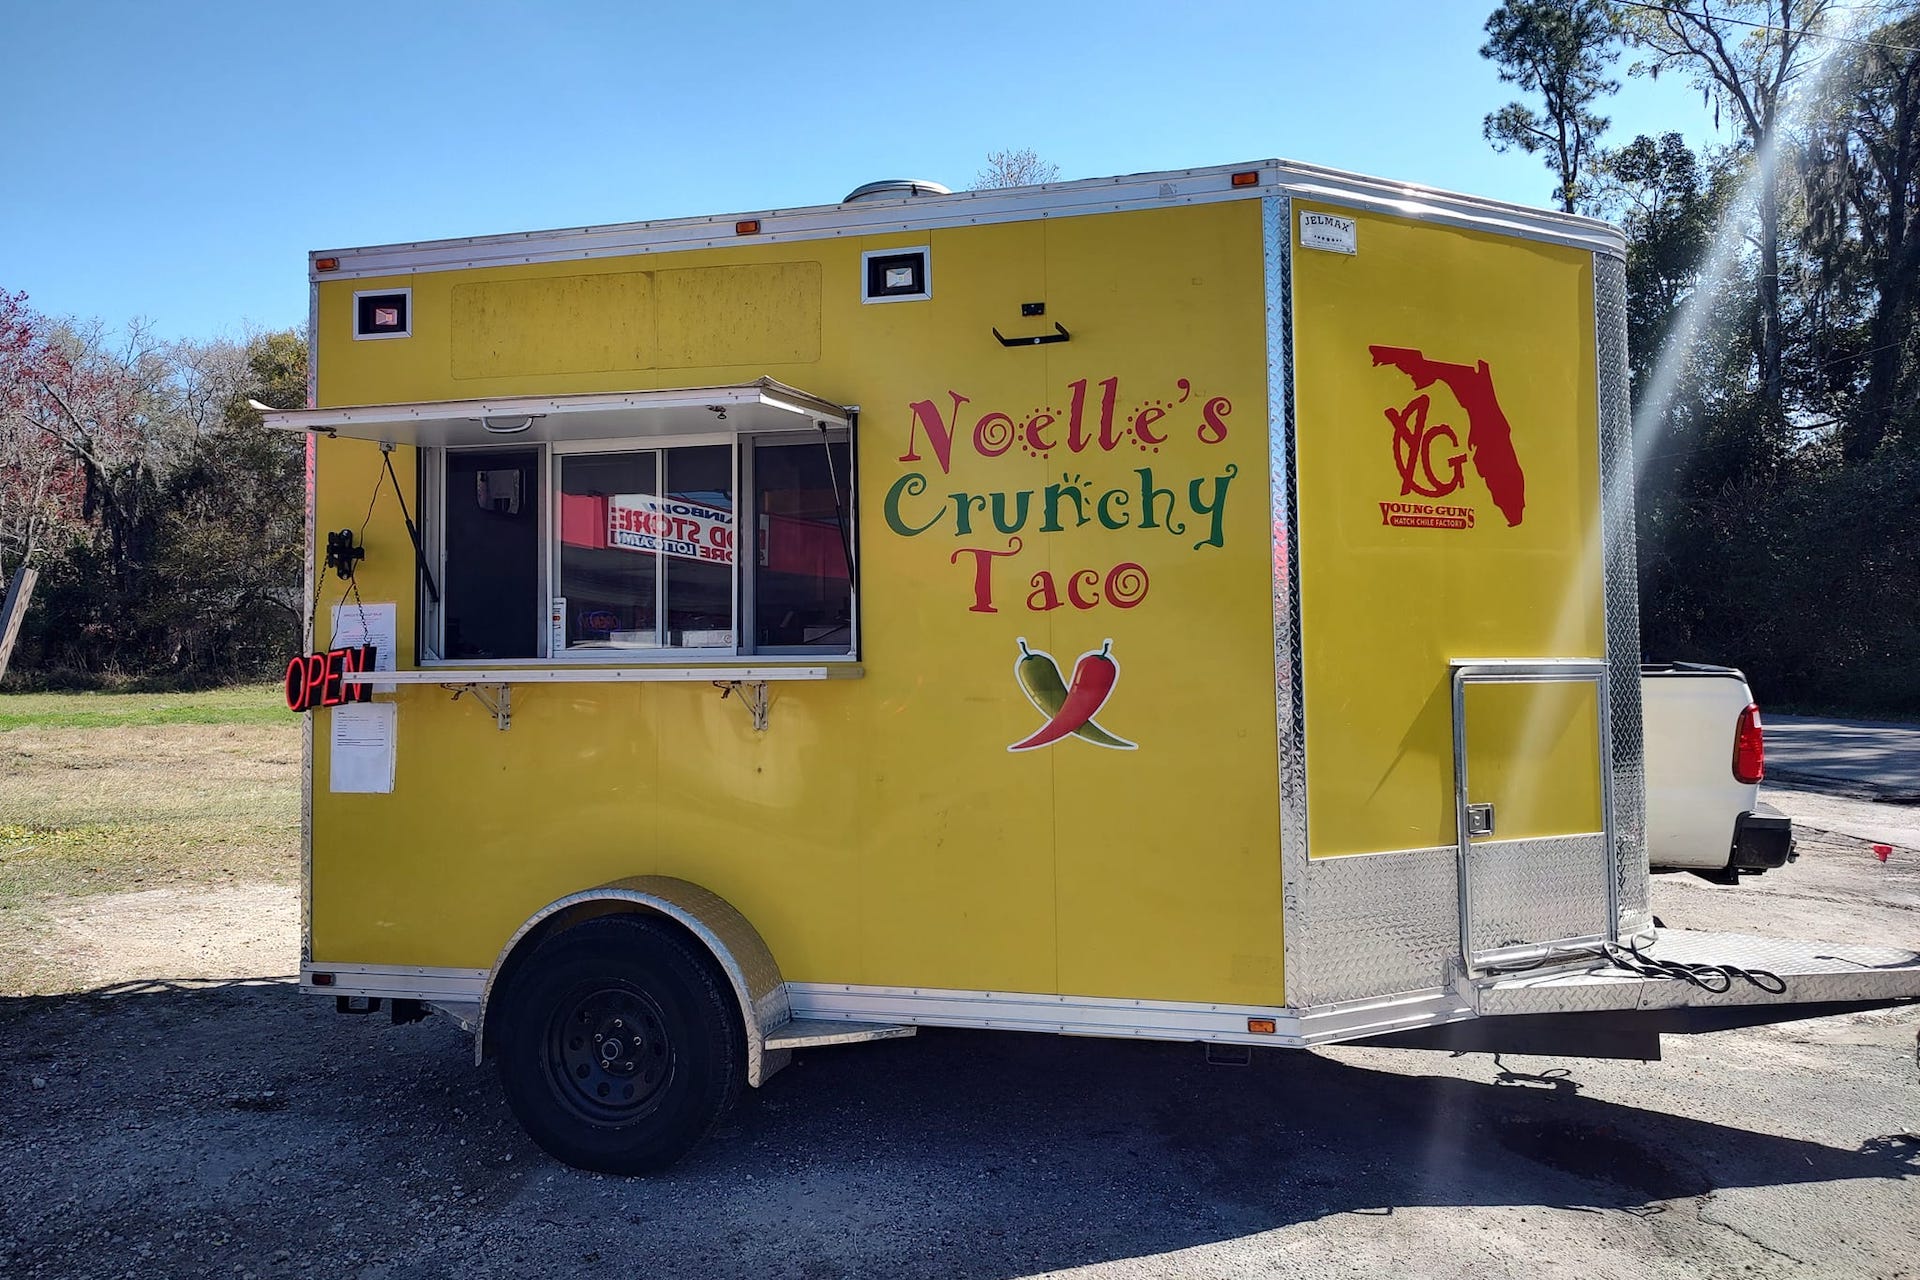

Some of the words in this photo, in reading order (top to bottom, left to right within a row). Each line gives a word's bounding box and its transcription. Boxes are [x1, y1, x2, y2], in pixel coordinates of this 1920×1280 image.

[1305, 215, 1350, 232] JELMAX
[898, 376, 1232, 474] Noelle's
[883, 463, 1238, 551] Crunchy
[1379, 502, 1434, 526] YOUNG
[1435, 505, 1475, 529] GUNS
[1394, 516, 1415, 526] HATCH
[1416, 518, 1434, 527] CHILE
[1435, 518, 1464, 528] FACTORY
[950, 536, 1149, 613] Taco
[285, 646, 366, 711] OPEN
